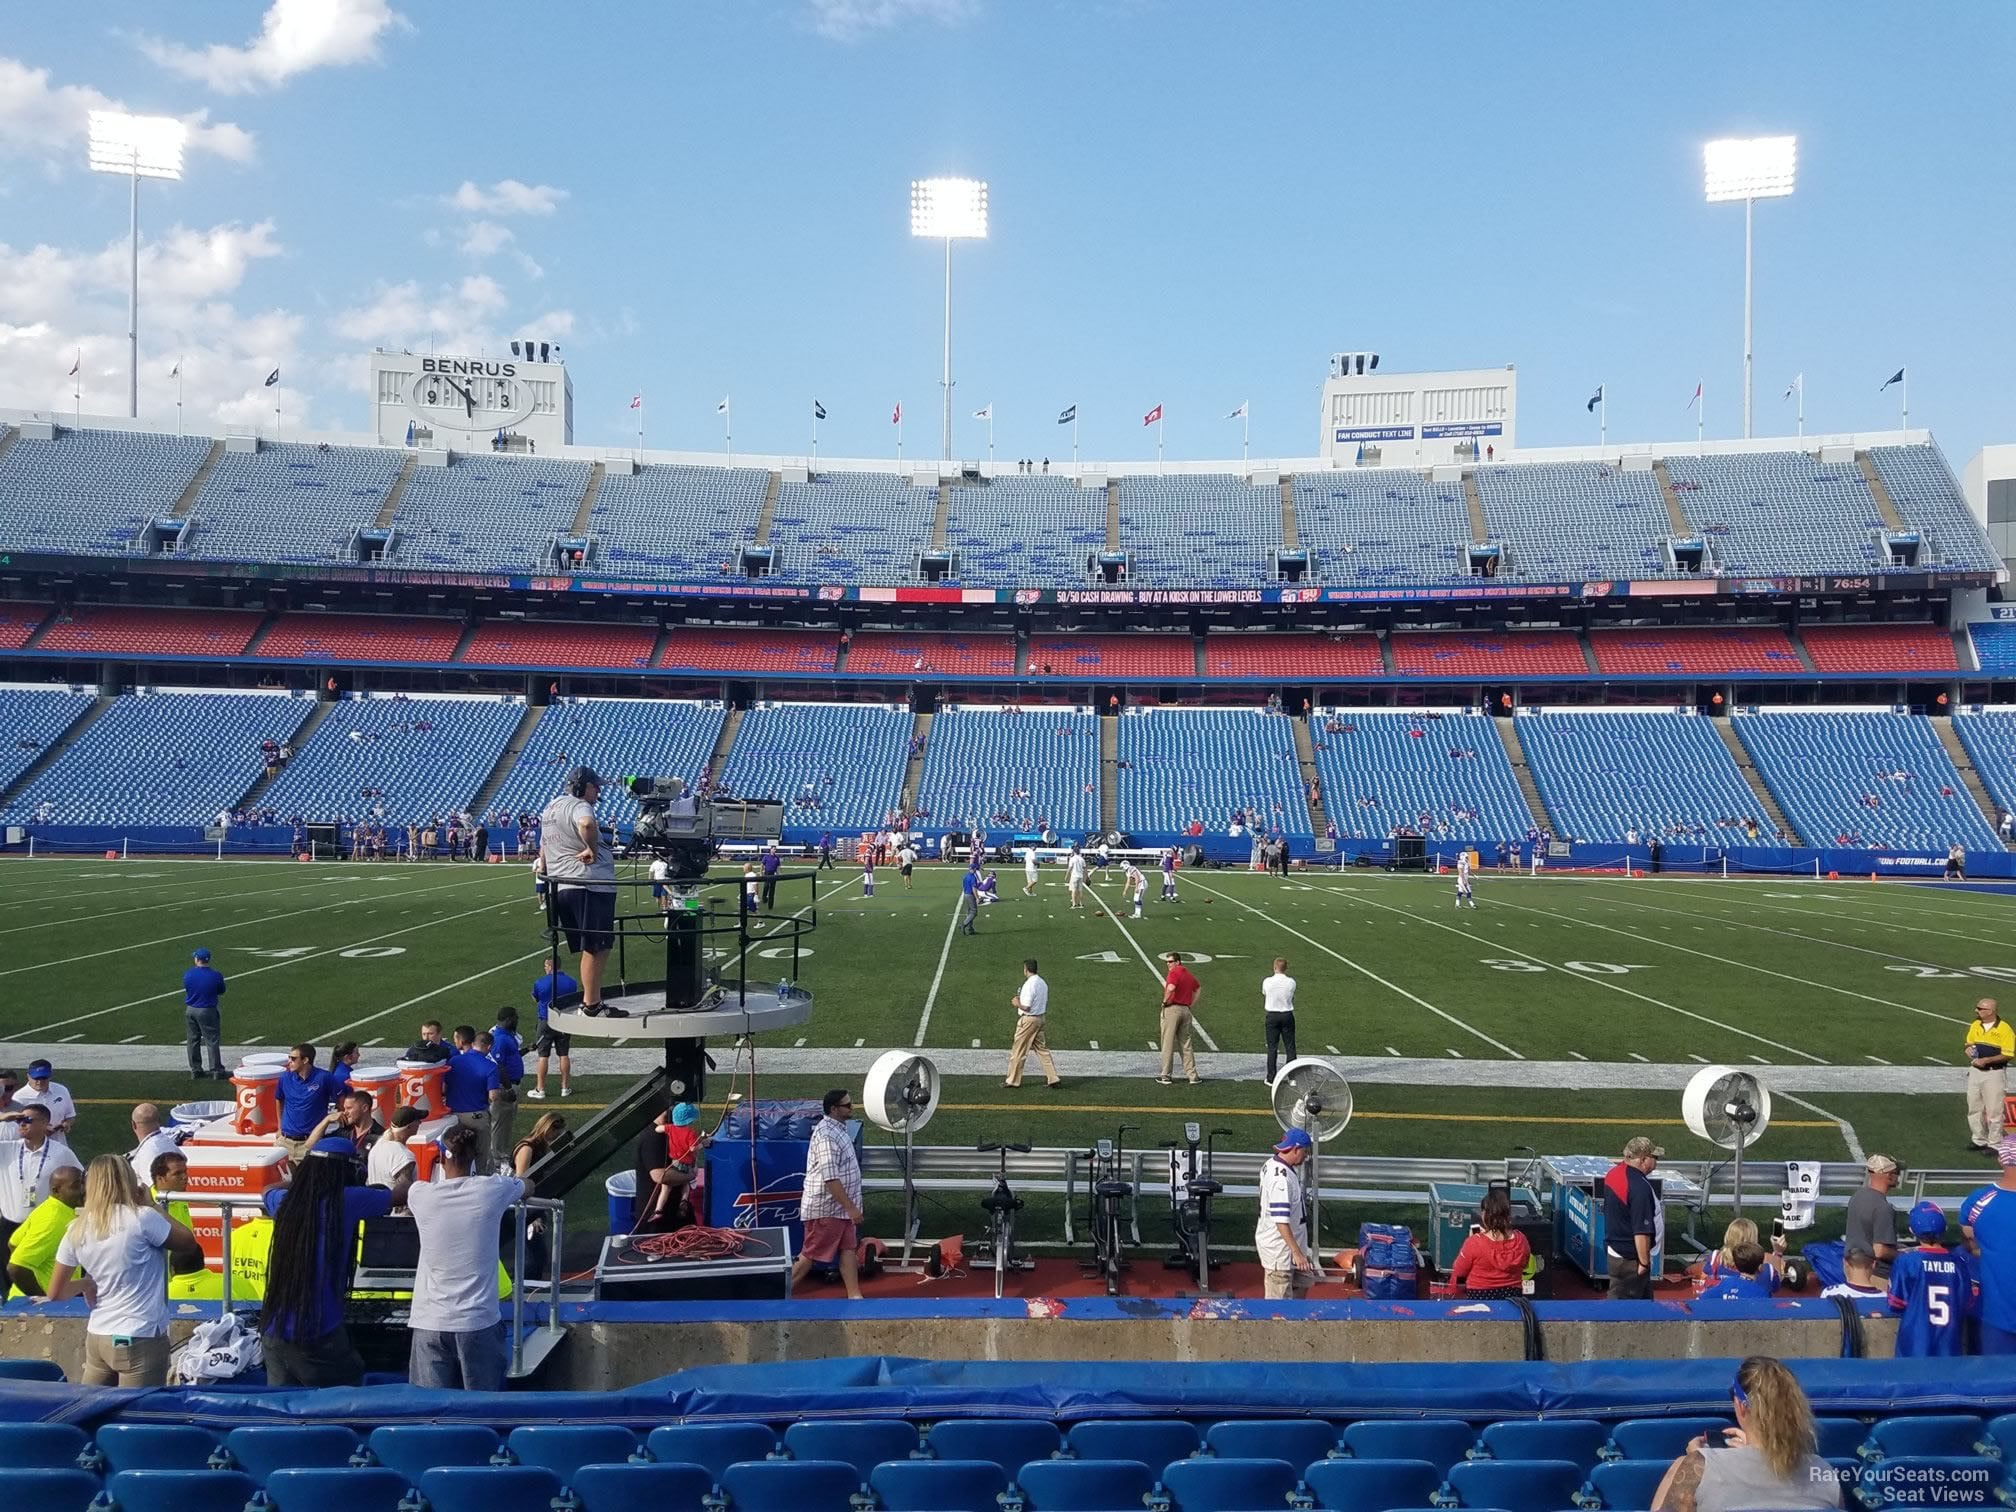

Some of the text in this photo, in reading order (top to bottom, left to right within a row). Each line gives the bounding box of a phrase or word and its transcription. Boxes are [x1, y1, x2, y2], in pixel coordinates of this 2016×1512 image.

[422, 358, 516, 377] BENRUS
[427, 390, 437, 404] 9
[500, 394, 510, 409] 3
[1338, 429, 1413, 440] FAN CONDUCT TEXT LINE
[485, 575, 511, 588] LEVELS
[1833, 578, 1870, 589] 76:54
[1056, 591, 1079, 603] 50/50
[1080, 591, 1099, 603] CASH
[1101, 591, 1134, 603] DRAWING
[1139, 591, 1153, 603] BUY
[1153, 591, 1162, 603] AT
[1162, 591, 1168, 603] A
[1169, 591, 1189, 603] KIOSK
[1190, 591, 1200, 603] ON
[1200, 591, 1214, 603] THE
[1214, 591, 1237, 603] LOWER
[1238, 590, 1262, 603] LEVELS
[1478, 959, 1630, 974] 30
[406, 1077, 424, 1097] G
[239, 1087, 257, 1108] G
[1274, 1166, 1287, 1177] 14
[187, 1176, 245, 1187] ATORADE
[1922, 1260, 1956, 1274] TAYLOR
[1928, 1285, 1950, 1326] 5
